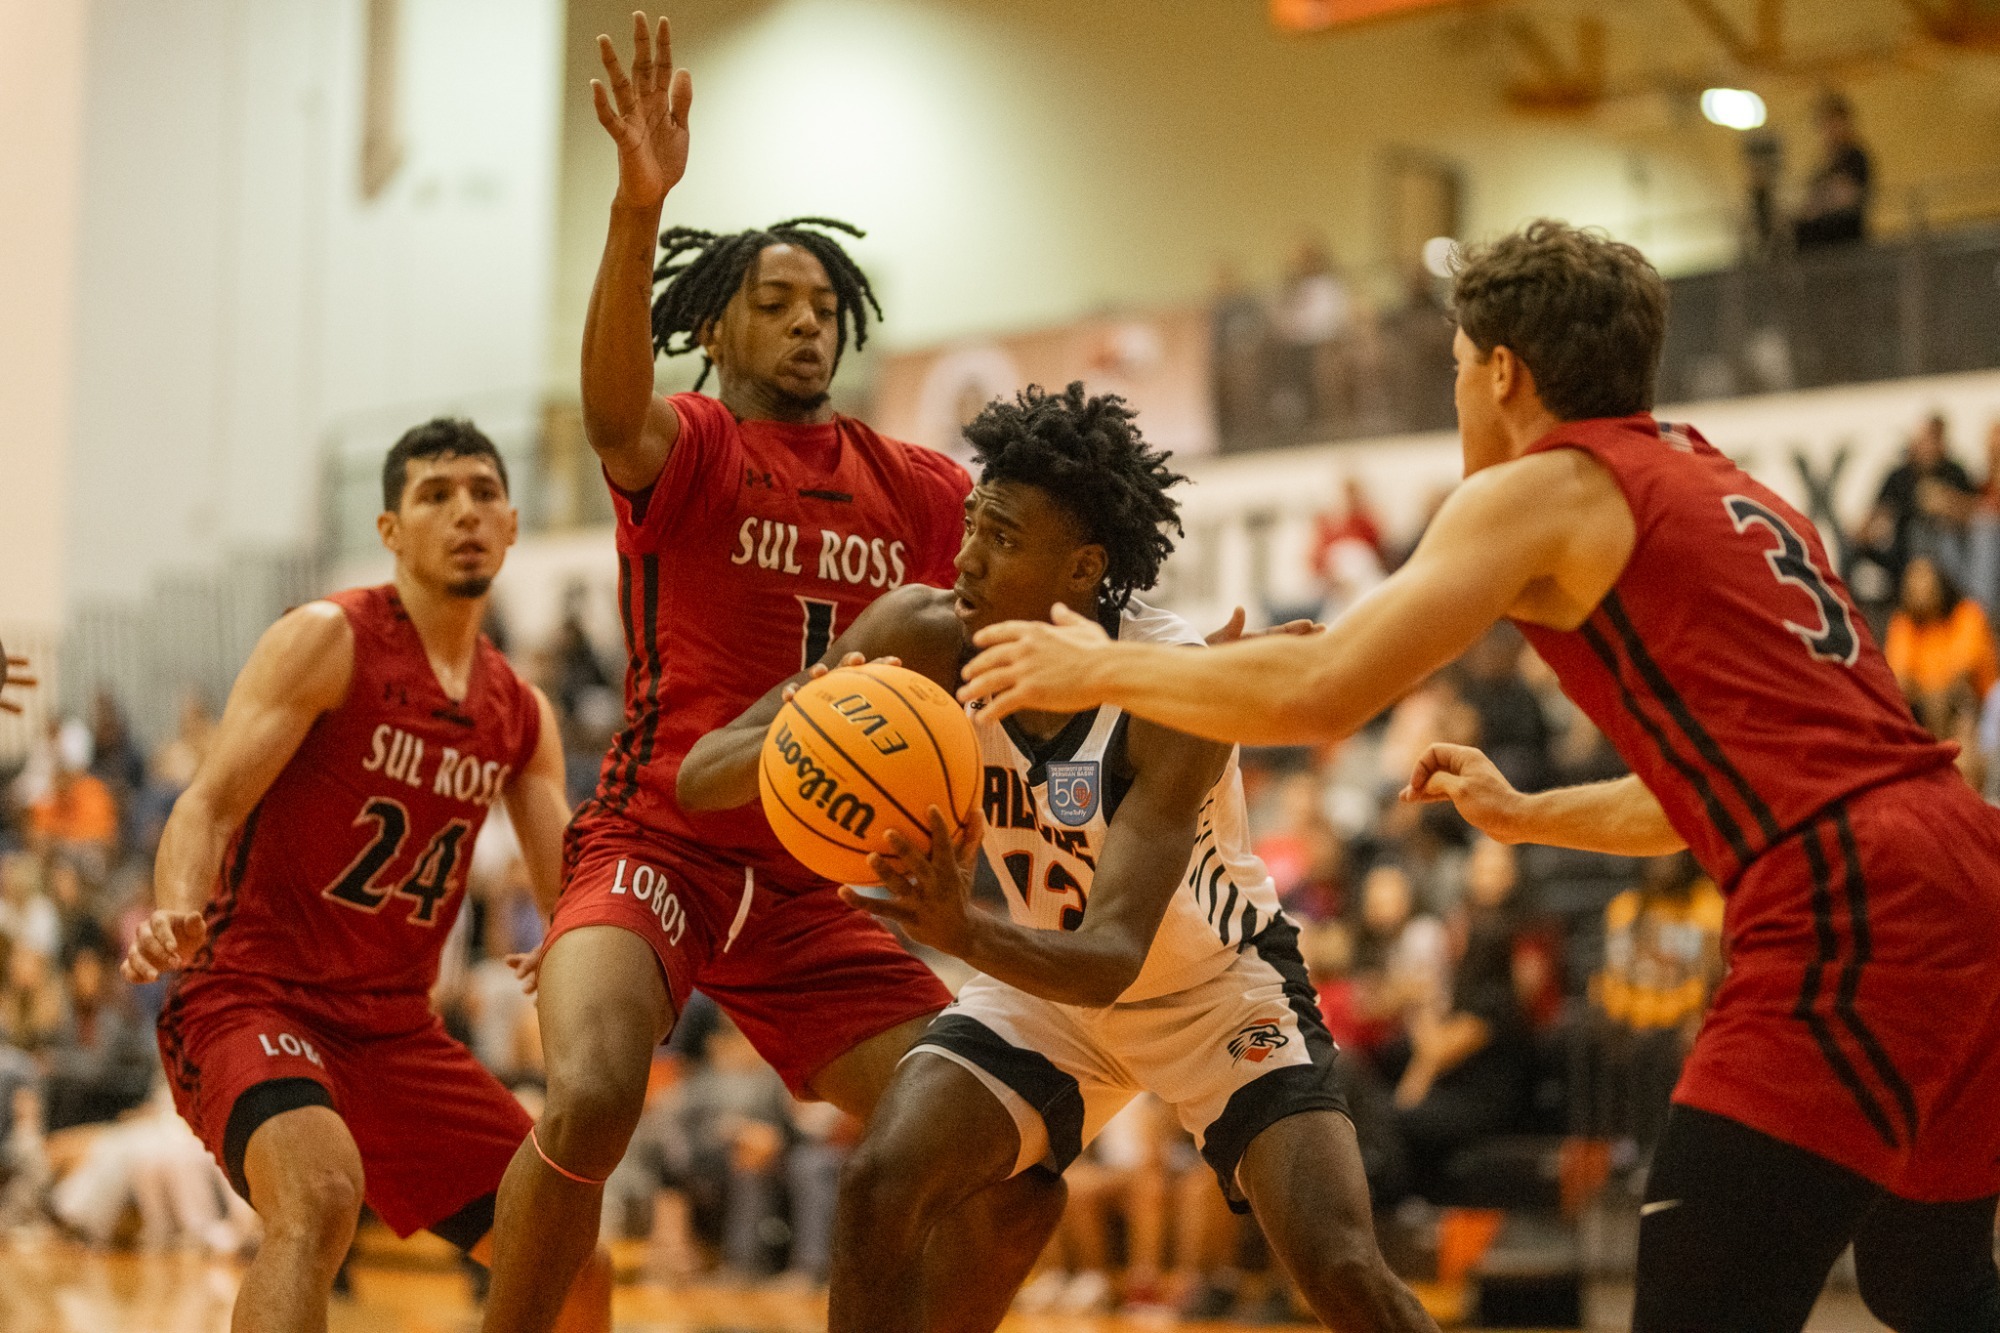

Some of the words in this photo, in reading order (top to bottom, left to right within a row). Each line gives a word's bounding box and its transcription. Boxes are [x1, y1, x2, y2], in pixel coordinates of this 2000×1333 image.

[731, 516, 802, 575] SUL
[817, 529, 906, 590] ROSS
[1722, 495, 1860, 666] 3
[794, 594, 839, 672] 1
[362, 723, 424, 788] SUL
[831, 693, 909, 755] EVO
[775, 722, 876, 839] Wilson
[1055, 778, 1091, 808] 50
[320, 796, 474, 928] 24
